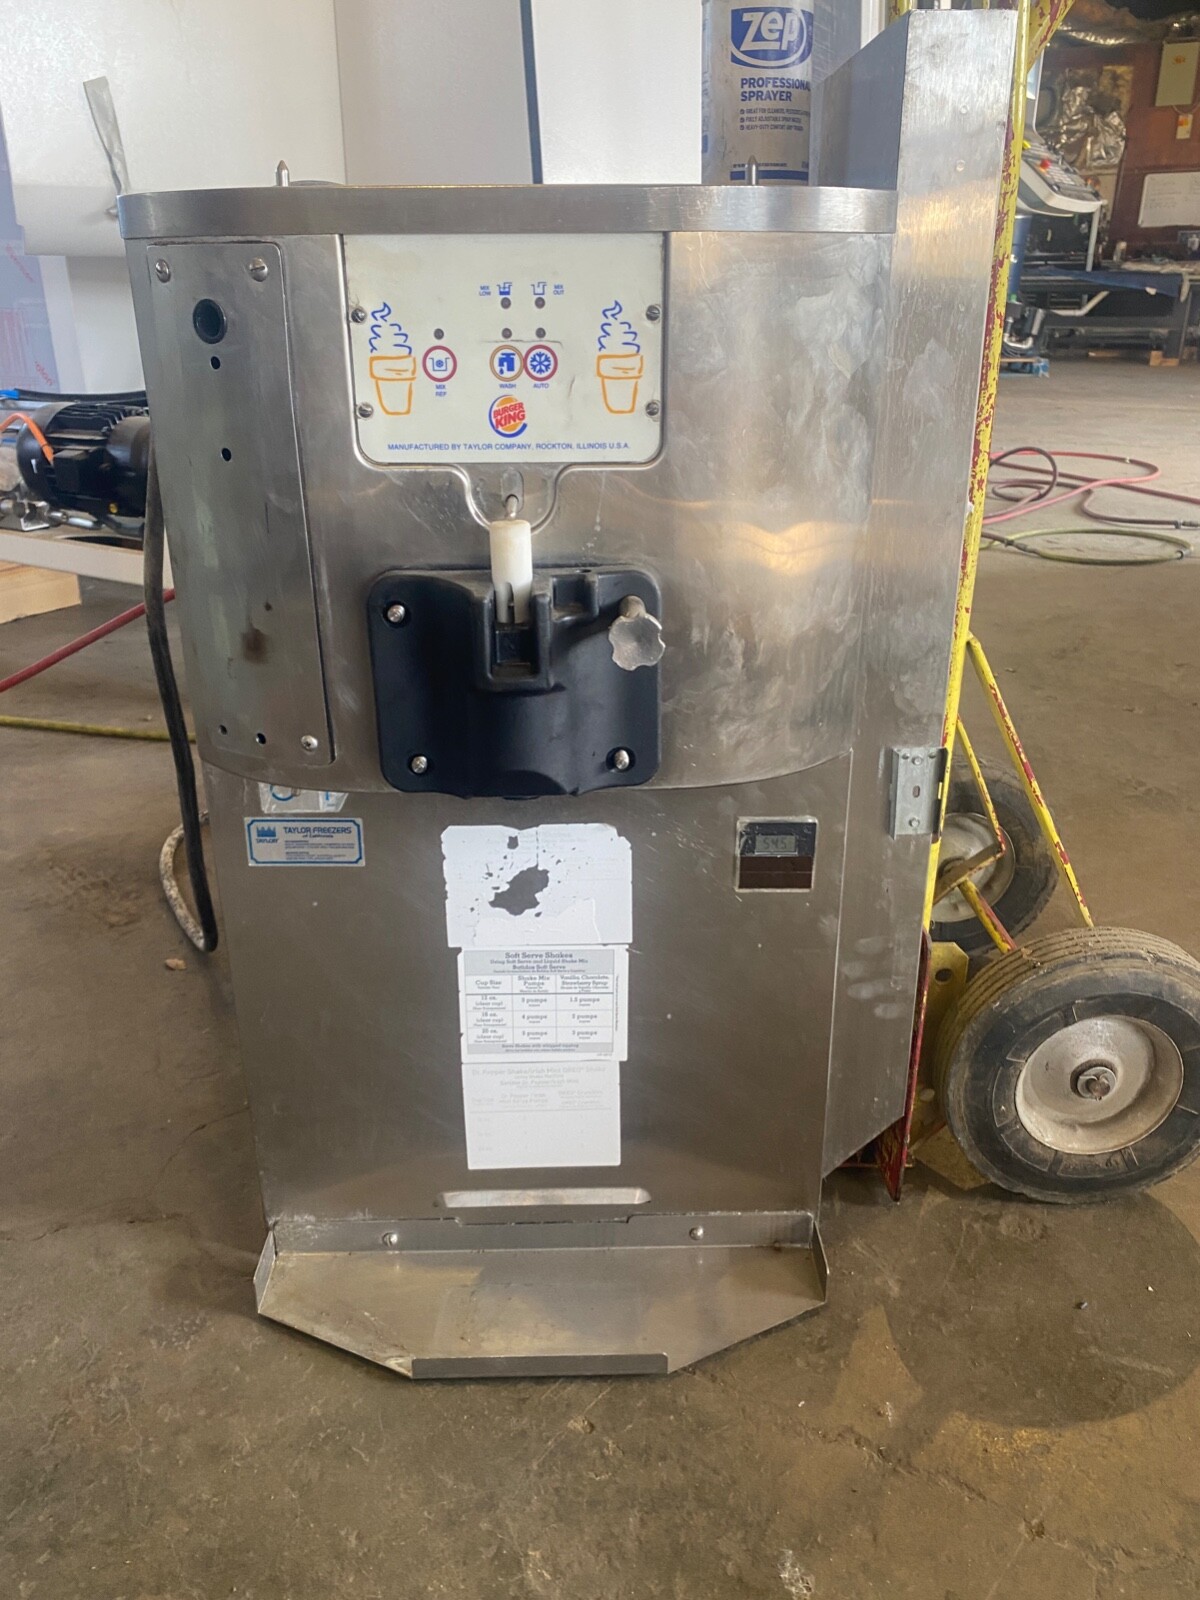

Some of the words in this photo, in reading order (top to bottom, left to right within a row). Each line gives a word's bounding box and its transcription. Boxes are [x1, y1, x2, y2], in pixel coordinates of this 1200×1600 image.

[741, 77, 811, 91] PROFESSIONA
[741, 90, 792, 101] SPRAYER
[493, 401, 525, 419] BURGER
[495, 410, 526, 429] KING
[283, 826, 311, 834] TAYLOR
[312, 826, 352, 834] FREEZERS
